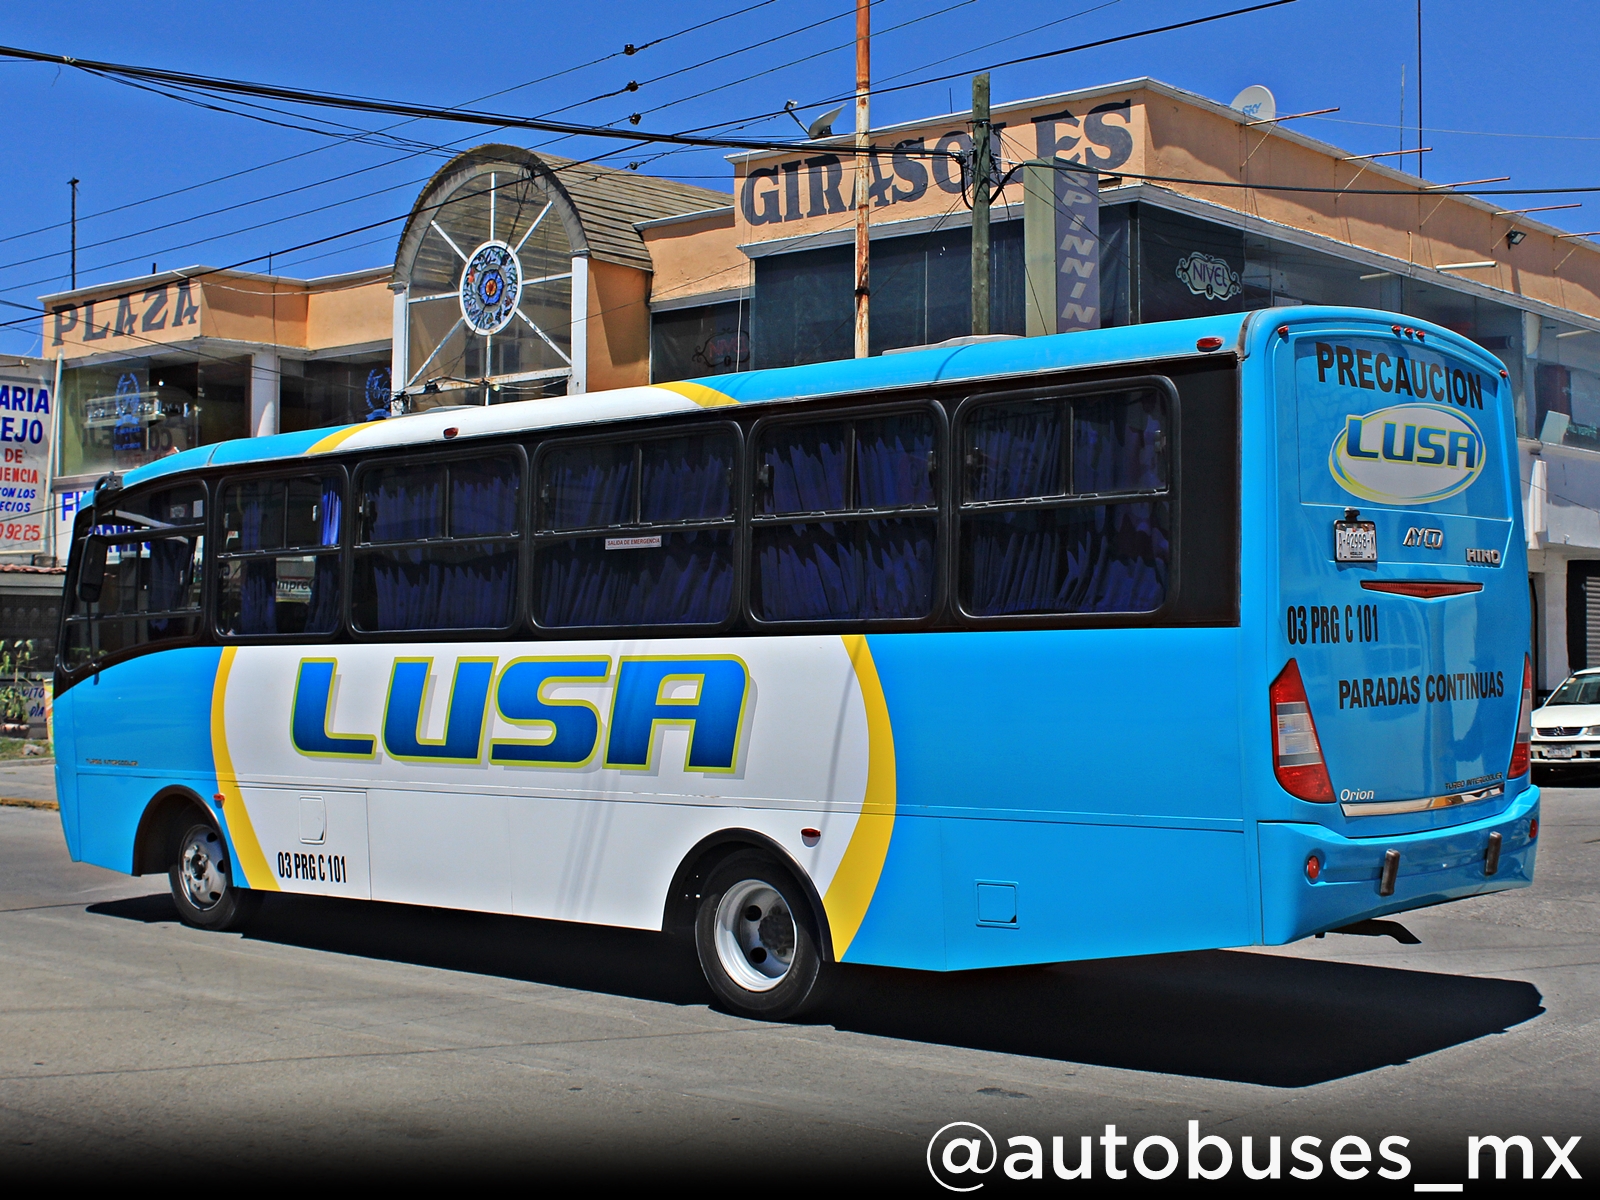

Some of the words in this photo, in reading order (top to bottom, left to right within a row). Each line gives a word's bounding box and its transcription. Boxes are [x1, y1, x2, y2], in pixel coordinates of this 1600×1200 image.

[1060, 170, 1097, 333] SPINNIN
[1192, 262, 1228, 287] NIVEL
[52, 279, 200, 346] PLAZA
[1315, 341, 1484, 410] PRECAUCION
[0, 384, 50, 415] ARIA
[1, 416, 44, 445] EJO
[1345, 414, 1477, 472] LUSA
[5, 448, 23, 464] DE
[17, 488, 36, 499] LOS
[1466, 548, 1501, 565] HINO
[1287, 605, 1308, 645] 03
[1311, 605, 1340, 644] PRG
[1345, 604, 1353, 643] C
[1356, 604, 1379, 643] 101
[1338, 674, 1420, 709] PARADAS
[1425, 670, 1504, 703] CONTINUAS
[289, 653, 754, 774] LUSA
[1340, 788, 1374, 801] Orion
[277, 851, 292, 879] 03
[294, 852, 316, 881] PRG
[318, 853, 326, 882] C
[327, 854, 347, 884] 101
